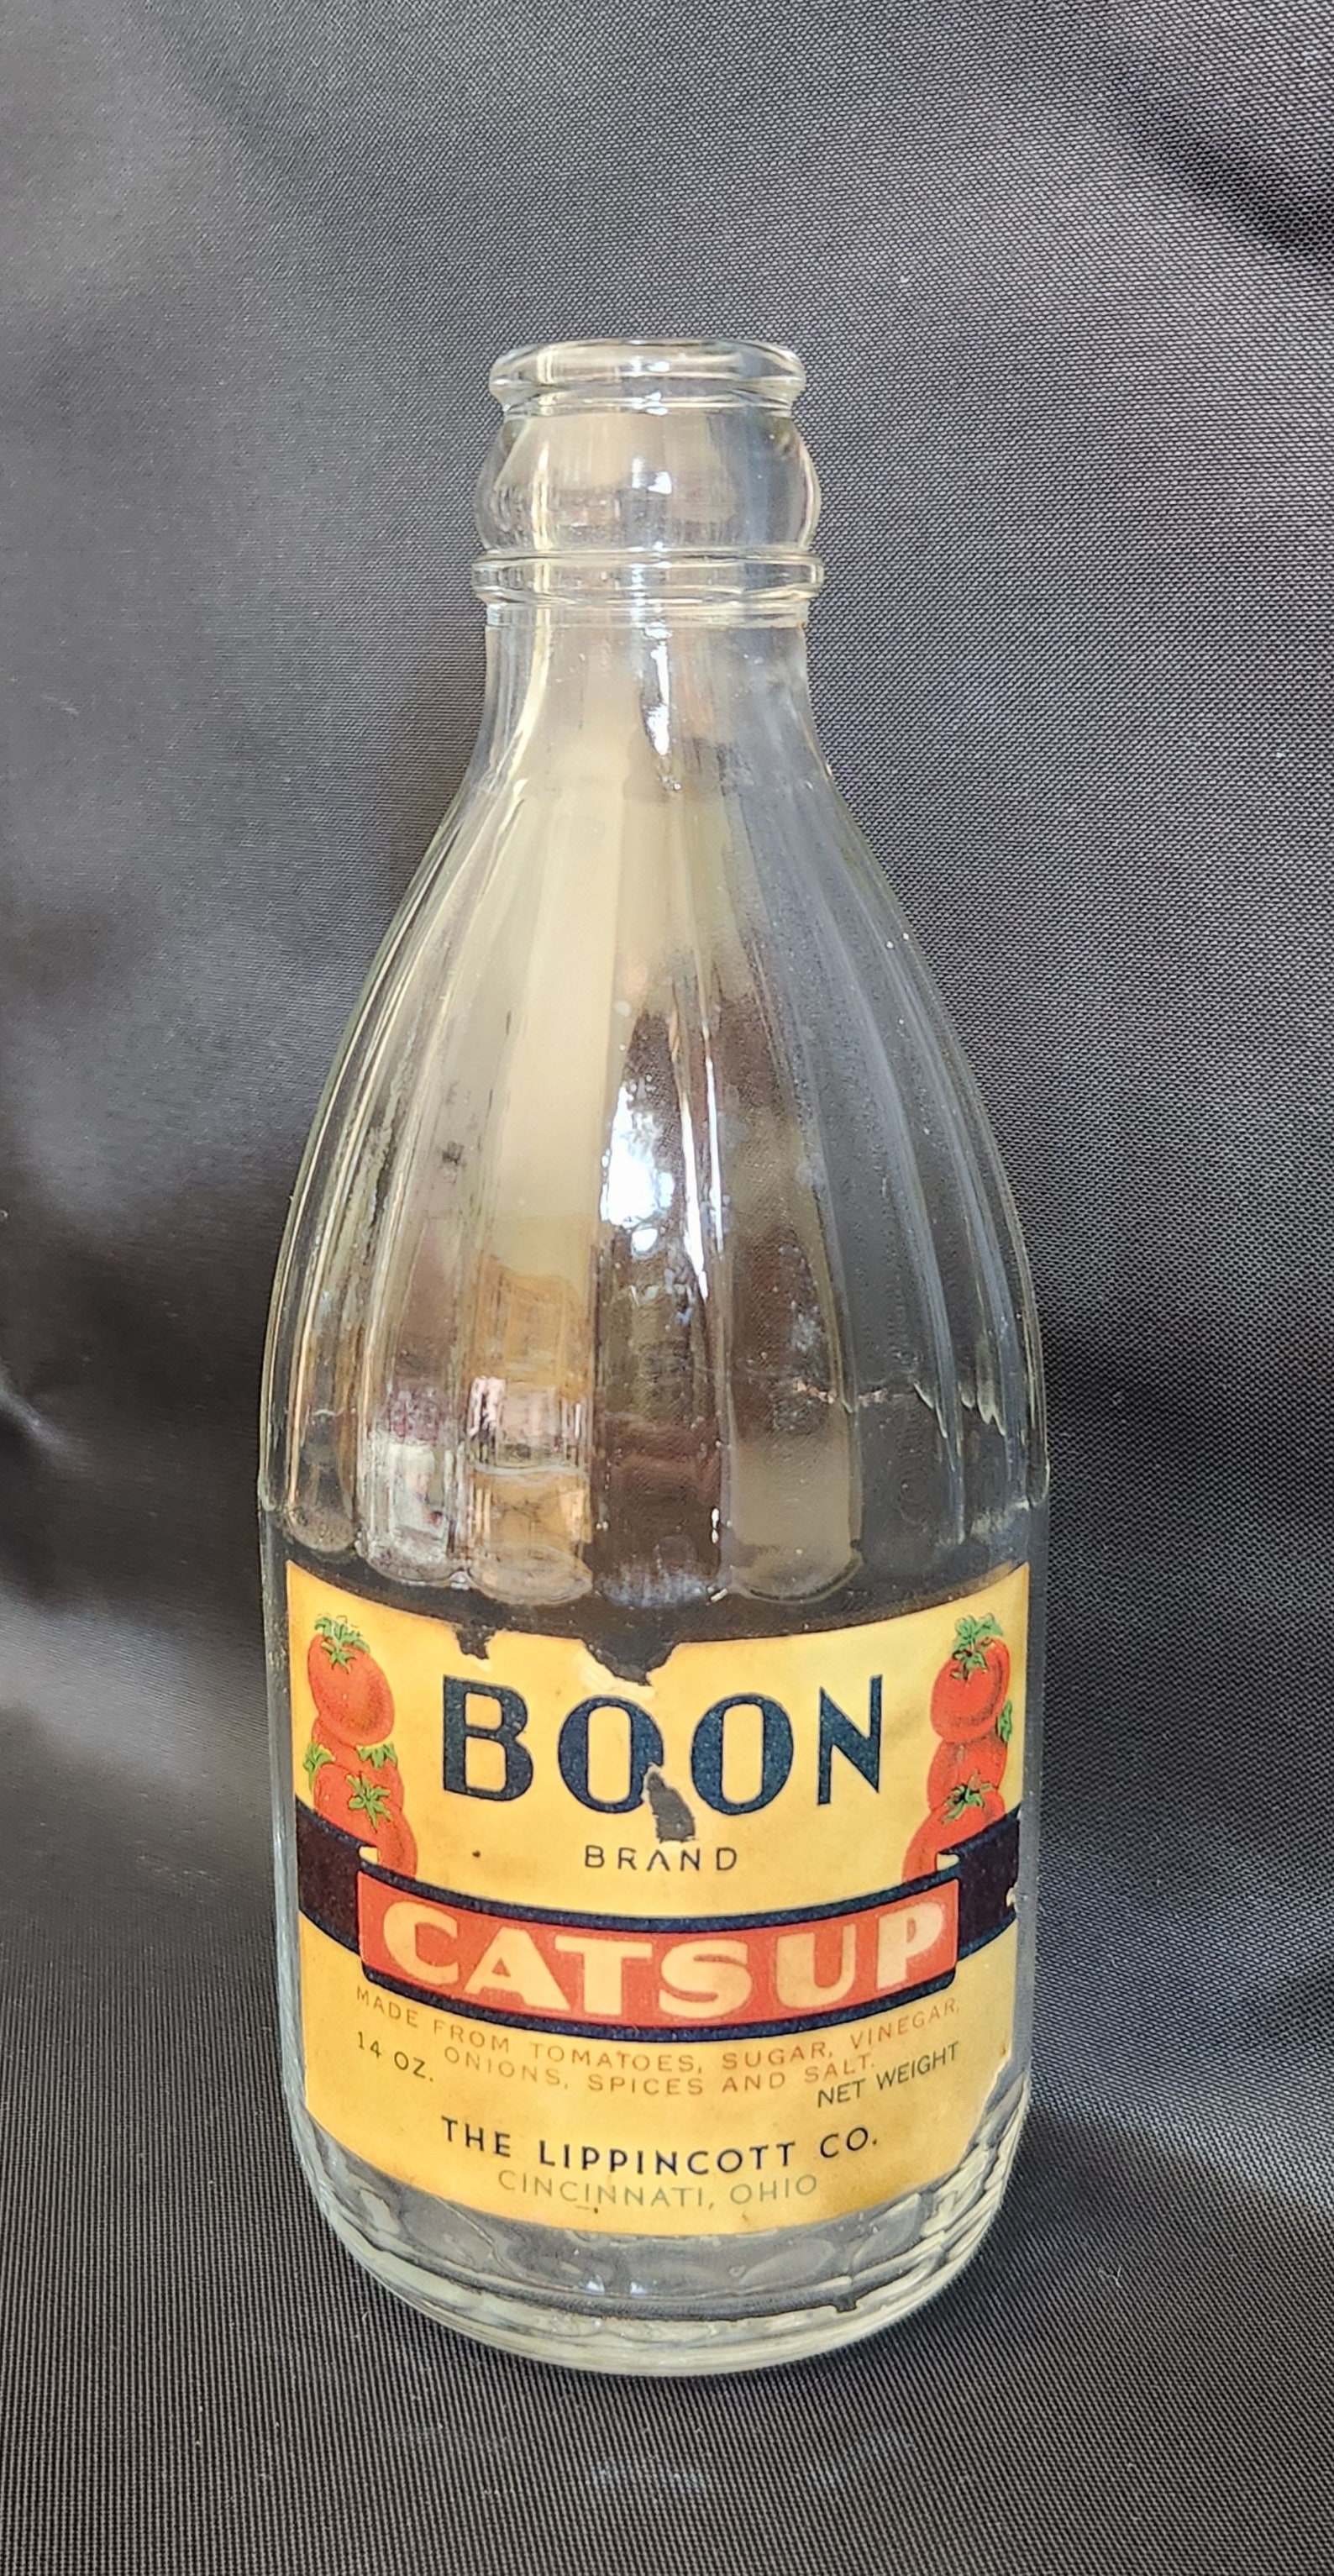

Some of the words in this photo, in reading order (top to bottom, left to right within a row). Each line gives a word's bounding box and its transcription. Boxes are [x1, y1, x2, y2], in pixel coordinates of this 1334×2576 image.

[443, 1674, 883, 1816] BOON
[584, 1845, 738, 1873] BRAND
[383, 1900, 944, 2017] CATSUP
[356, 1985, 419, 2027] MADE
[433, 2019, 510, 2053] FROM
[531, 2042, 703, 2074] TOMATOES,
[722, 2041, 833, 2069] SUGAR,
[849, 1997, 960, 2051] VINEGAR,
[358, 2030, 381, 2059] 14
[393, 2051, 434, 2082] OZ.
[444, 2046, 570, 2090] ONIONS,
[588, 2074, 704, 2096] SPICES
[721, 2071, 786, 2094] AND
[804, 2053, 874, 2084] SALT.
[817, 2079, 866, 2109] NET
[876, 2041, 959, 2090] WEIGHT
[440, 2115, 512, 2158] THE
[538, 2139, 796, 2176] LIPPINCOTT
[819, 2127, 878, 2159] CO.
[498, 2169, 714, 2211] CINCINNATI,
[729, 2174, 817, 2205] OHIO
